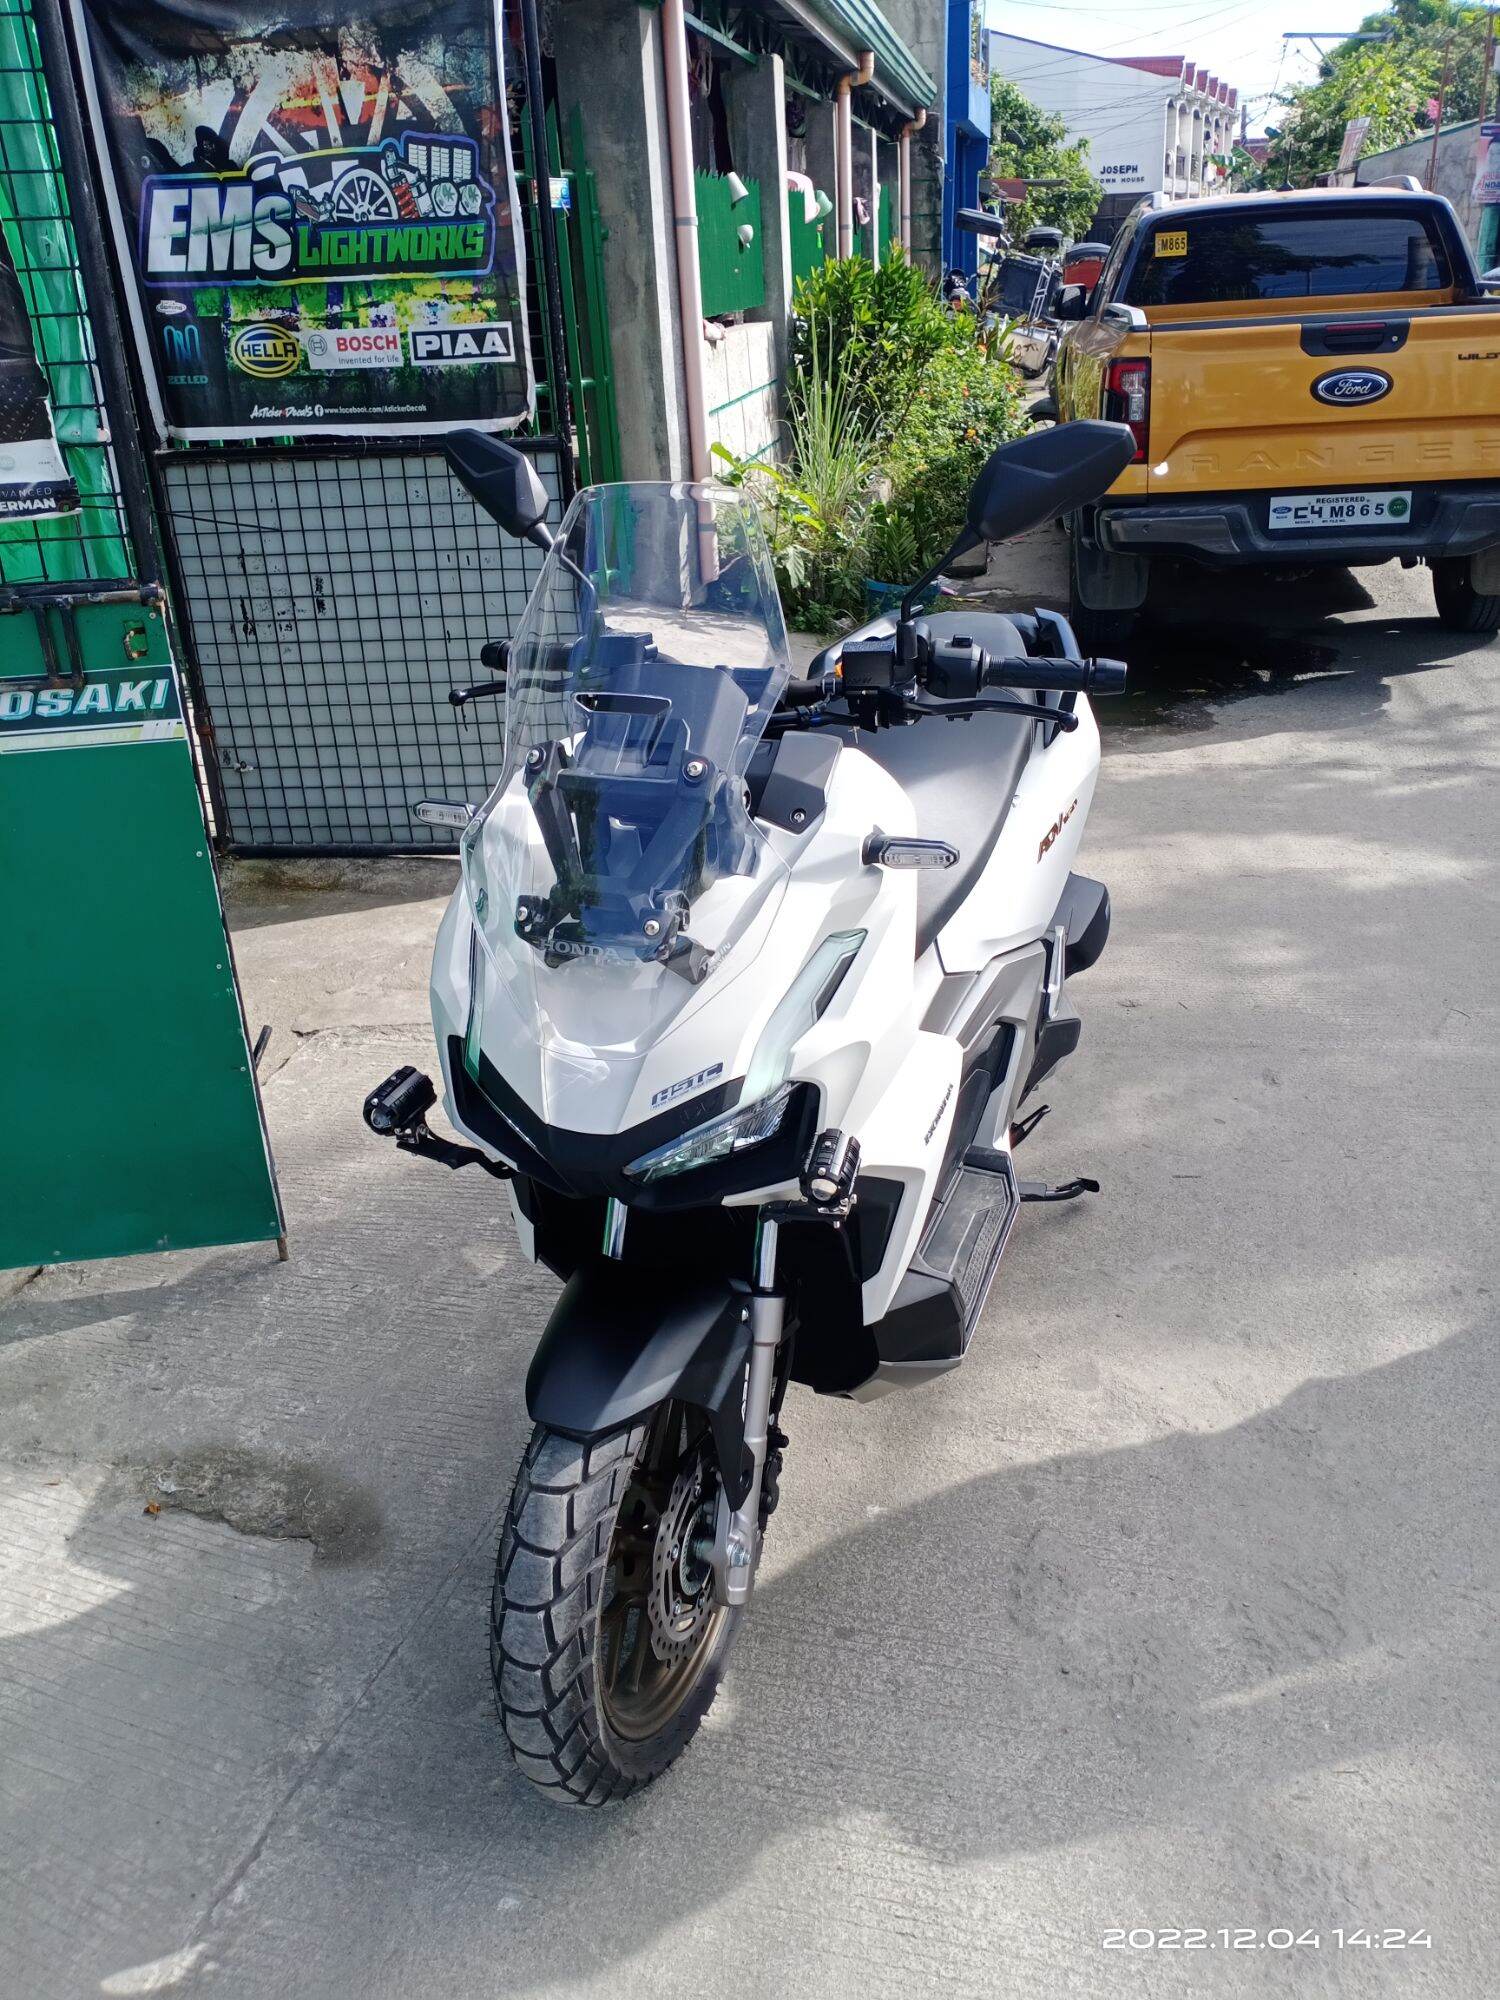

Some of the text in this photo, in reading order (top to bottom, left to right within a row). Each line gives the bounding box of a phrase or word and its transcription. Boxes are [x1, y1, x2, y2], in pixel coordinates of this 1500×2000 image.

[1100, 164, 1138, 175] JOSEPH
[299, 219, 486, 267] LIGHTWORKS
[1161, 237, 1186, 251] M865
[240, 341, 298, 358] HELLA
[336, 334, 398, 353] BOSCH
[415, 331, 508, 358] PIAA
[338, 354, 400, 365] Invented for life
[1457, 352, 1500, 361] WILD
[1334, 378, 1372, 396] Ford
[1315, 496, 1366, 504] REGISTERED
[0, 678, 170, 721] OSAKI
[539, 938, 618, 958] HONDA
